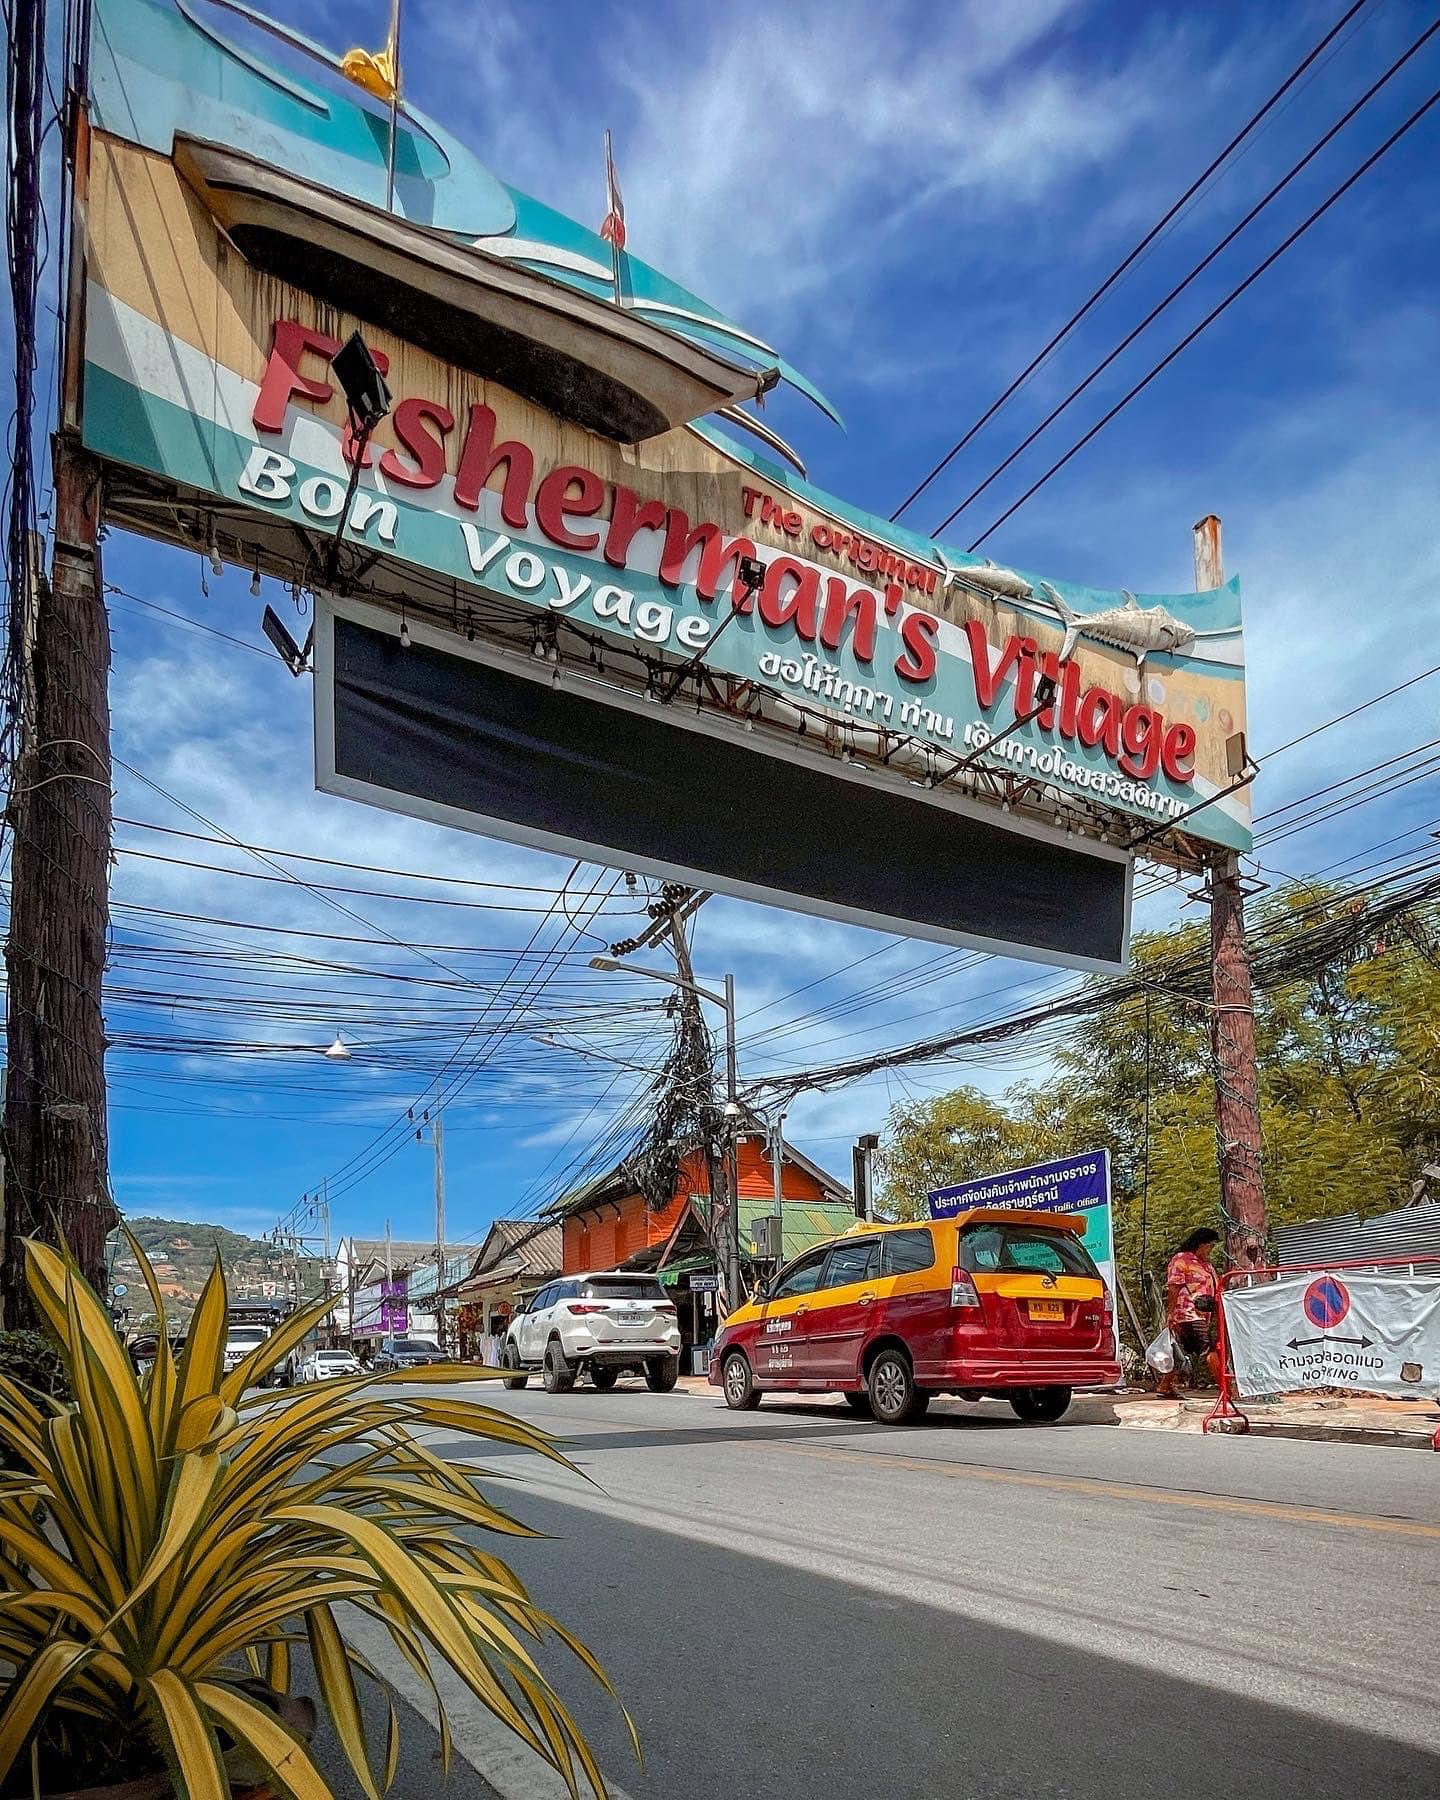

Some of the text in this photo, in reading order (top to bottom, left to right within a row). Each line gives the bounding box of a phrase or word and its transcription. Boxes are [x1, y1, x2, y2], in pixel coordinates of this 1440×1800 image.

[238, 446, 711, 650] Bon Voyage
[742, 486, 803, 535] The
[900, 697, 954, 738] ท่าน
[965, 619, 1196, 782] Village
